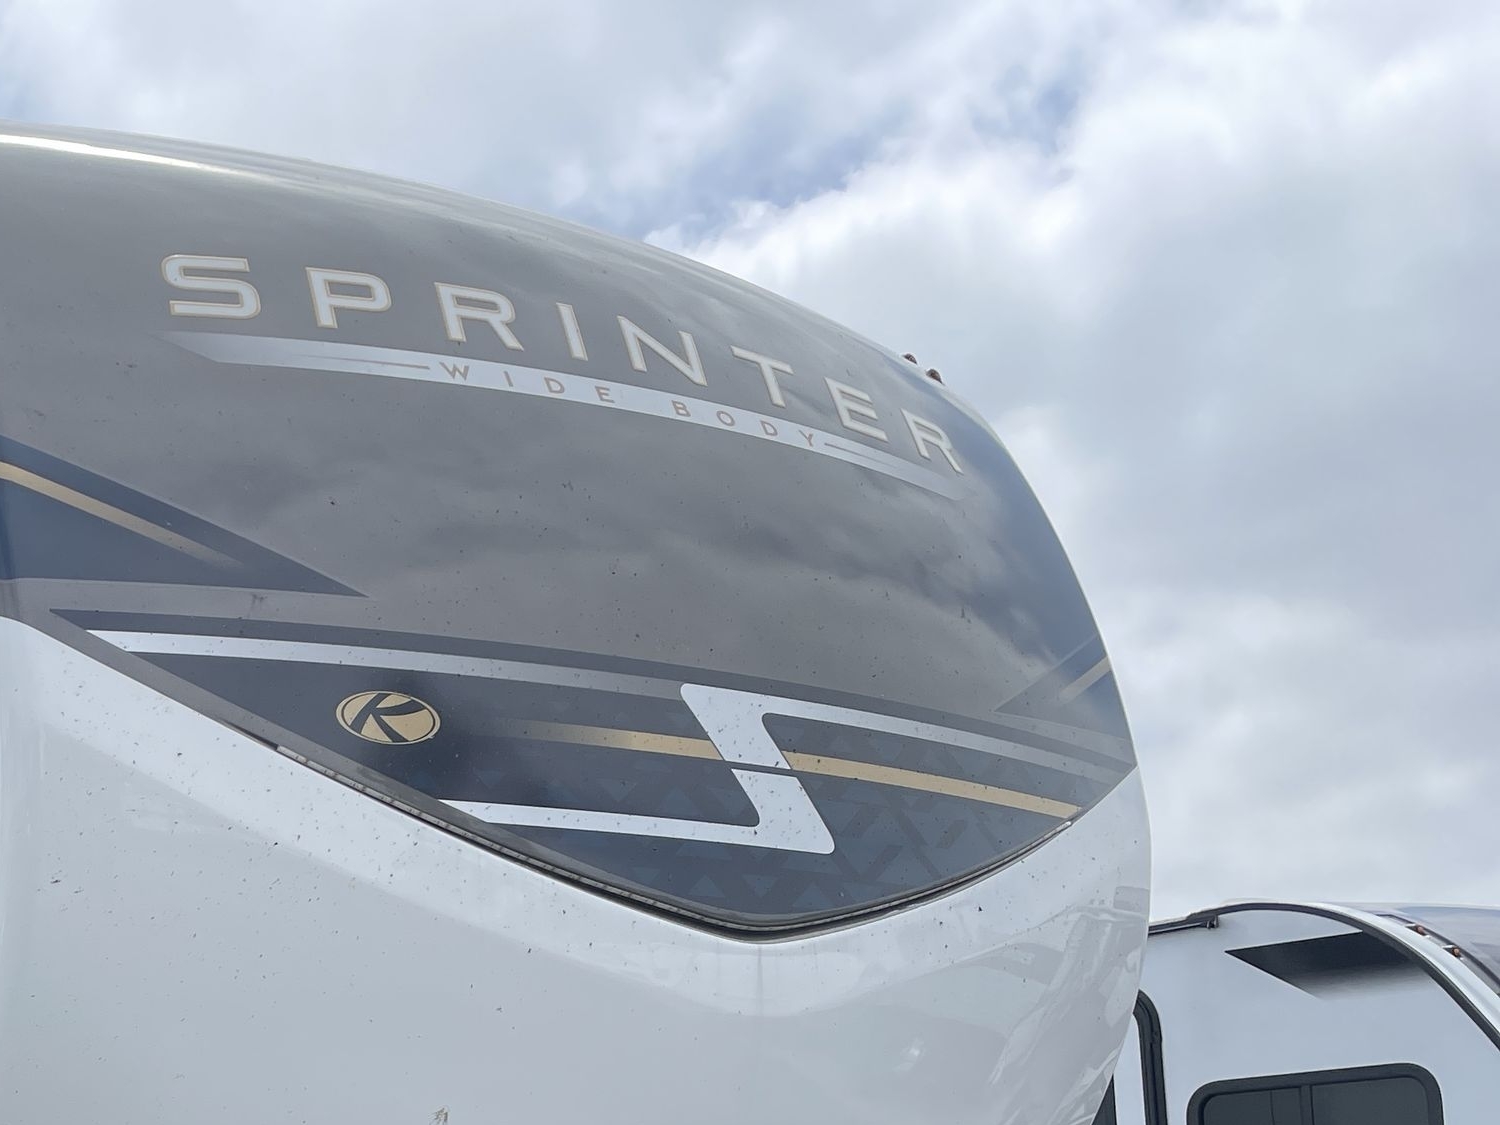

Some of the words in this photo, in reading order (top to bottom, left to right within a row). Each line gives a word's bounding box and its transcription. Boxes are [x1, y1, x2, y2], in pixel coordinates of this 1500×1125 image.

[160, 254, 964, 474] SPRINTER
[439, 361, 615, 404] WIDE
[672, 400, 814, 448] BODY
